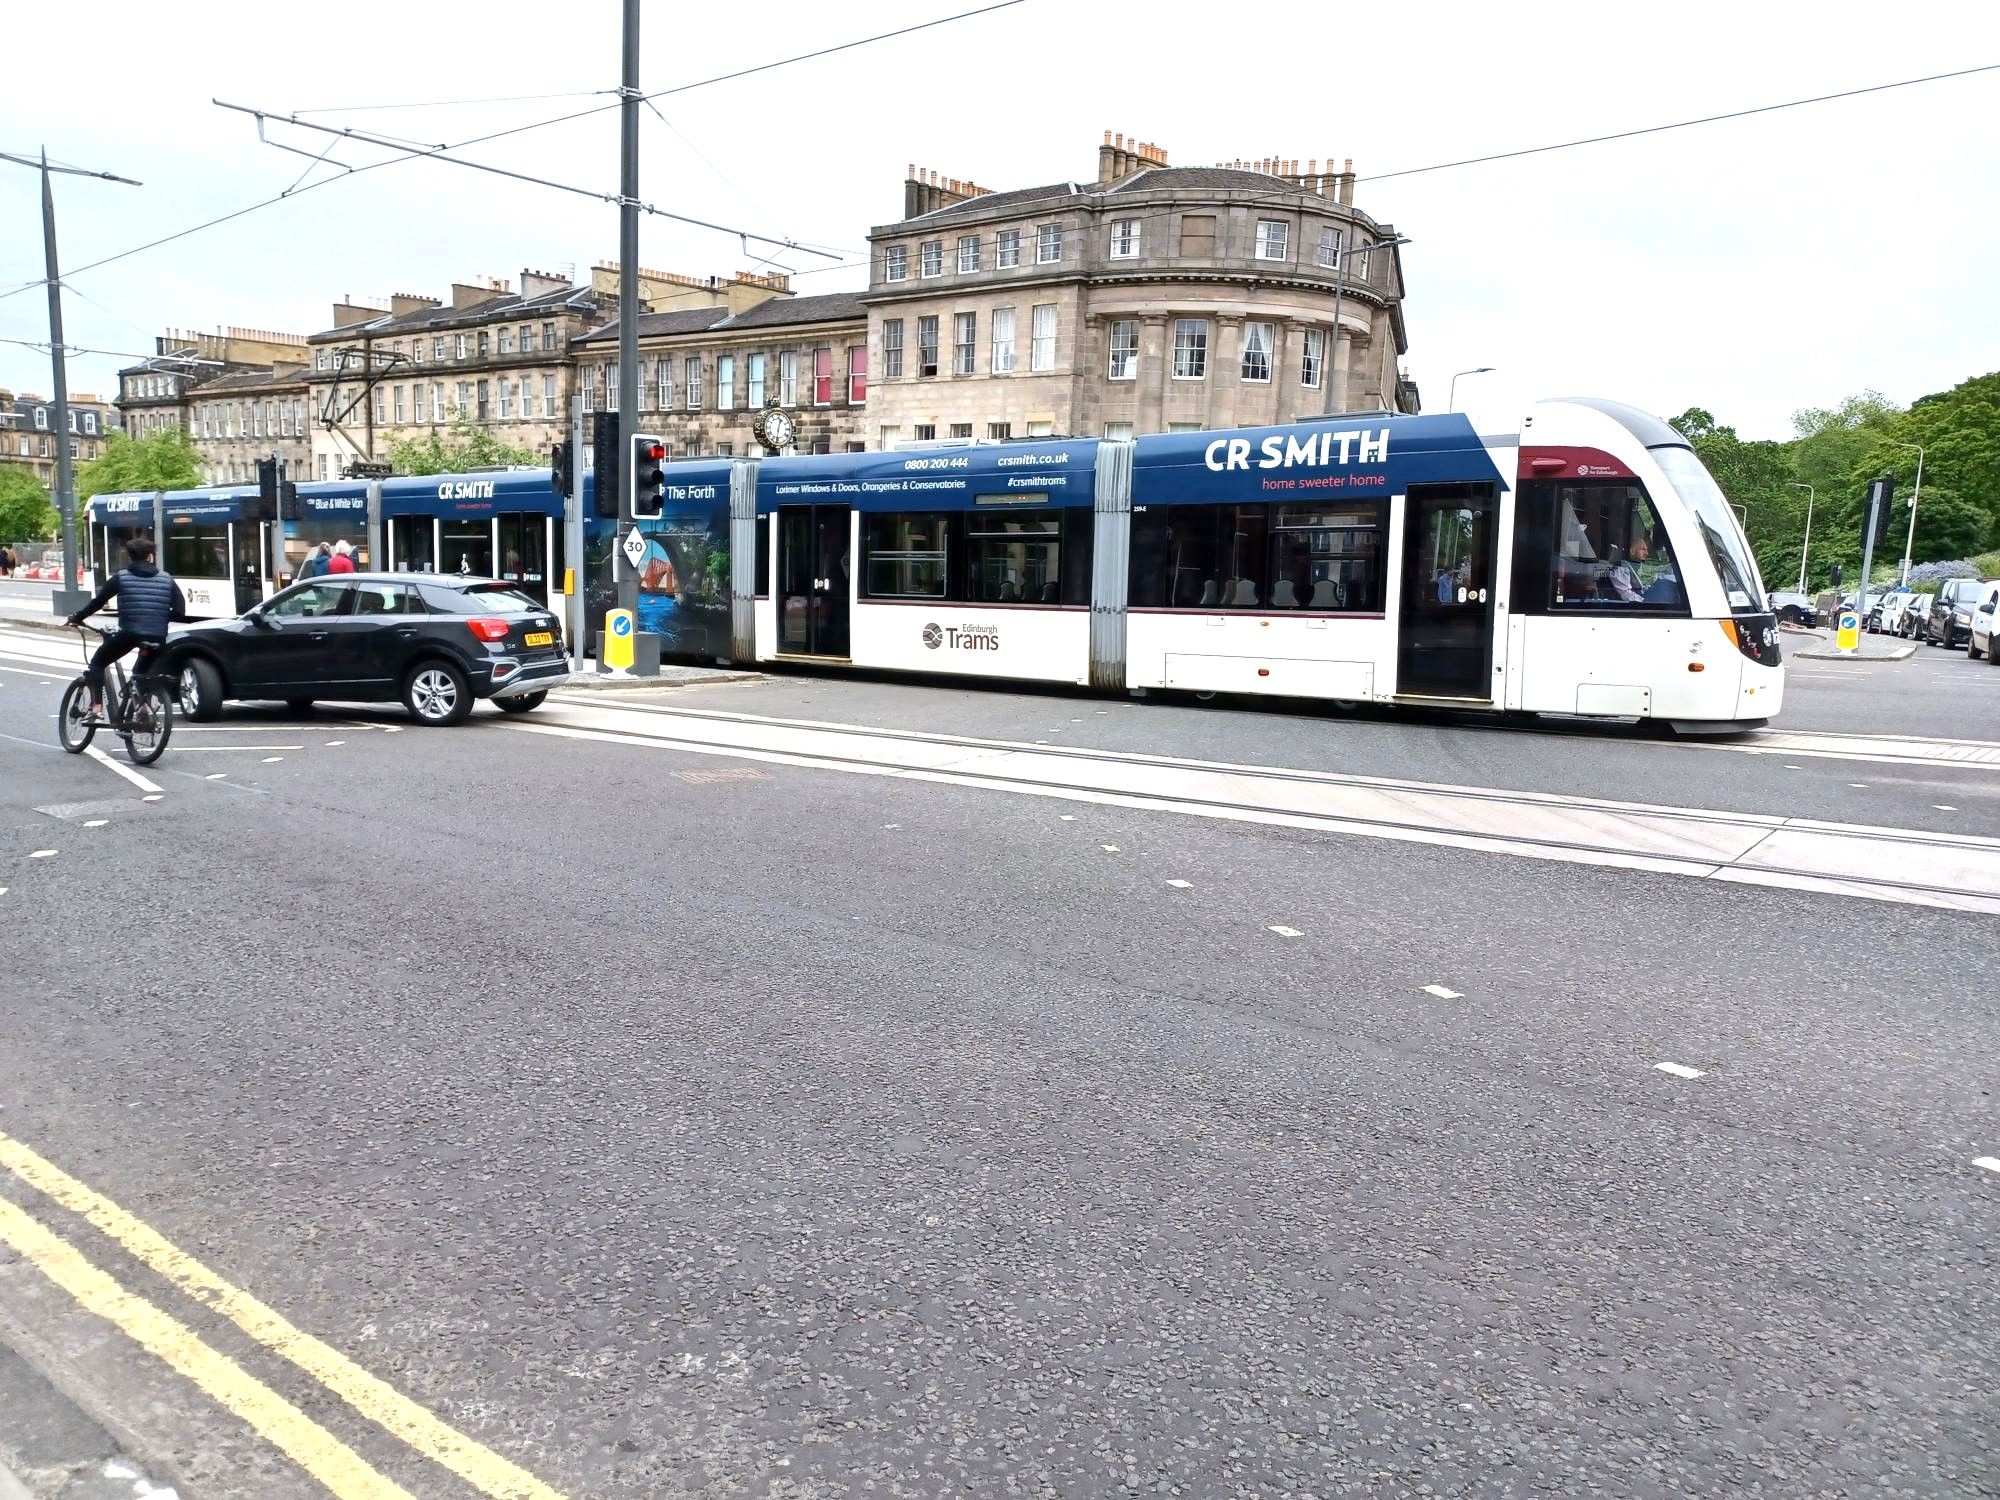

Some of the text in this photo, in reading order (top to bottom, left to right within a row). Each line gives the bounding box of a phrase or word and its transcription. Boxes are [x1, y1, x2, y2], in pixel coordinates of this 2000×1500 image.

[1204, 428, 1391, 471] CR SMITH
[904, 457, 969, 470] 0800 200 444
[998, 452, 1069, 466] crsmith.co.uk
[776, 480, 966, 494] Lorimer Windows & Doors, Orangeries & Conservatories
[1007, 476, 1067, 487] #crsmithtrams
[1262, 474, 1386, 490] home sweeter home
[438, 480, 495, 500] CR SMITH
[668, 486, 686, 500] The
[688, 485, 715, 499] Forth
[315, 499, 328, 510] Blue
[335, 498, 351, 509] White
[627, 541, 643, 553] 30
[962, 623, 998, 635] Edinburgh
[945, 627, 999, 651] Trams
